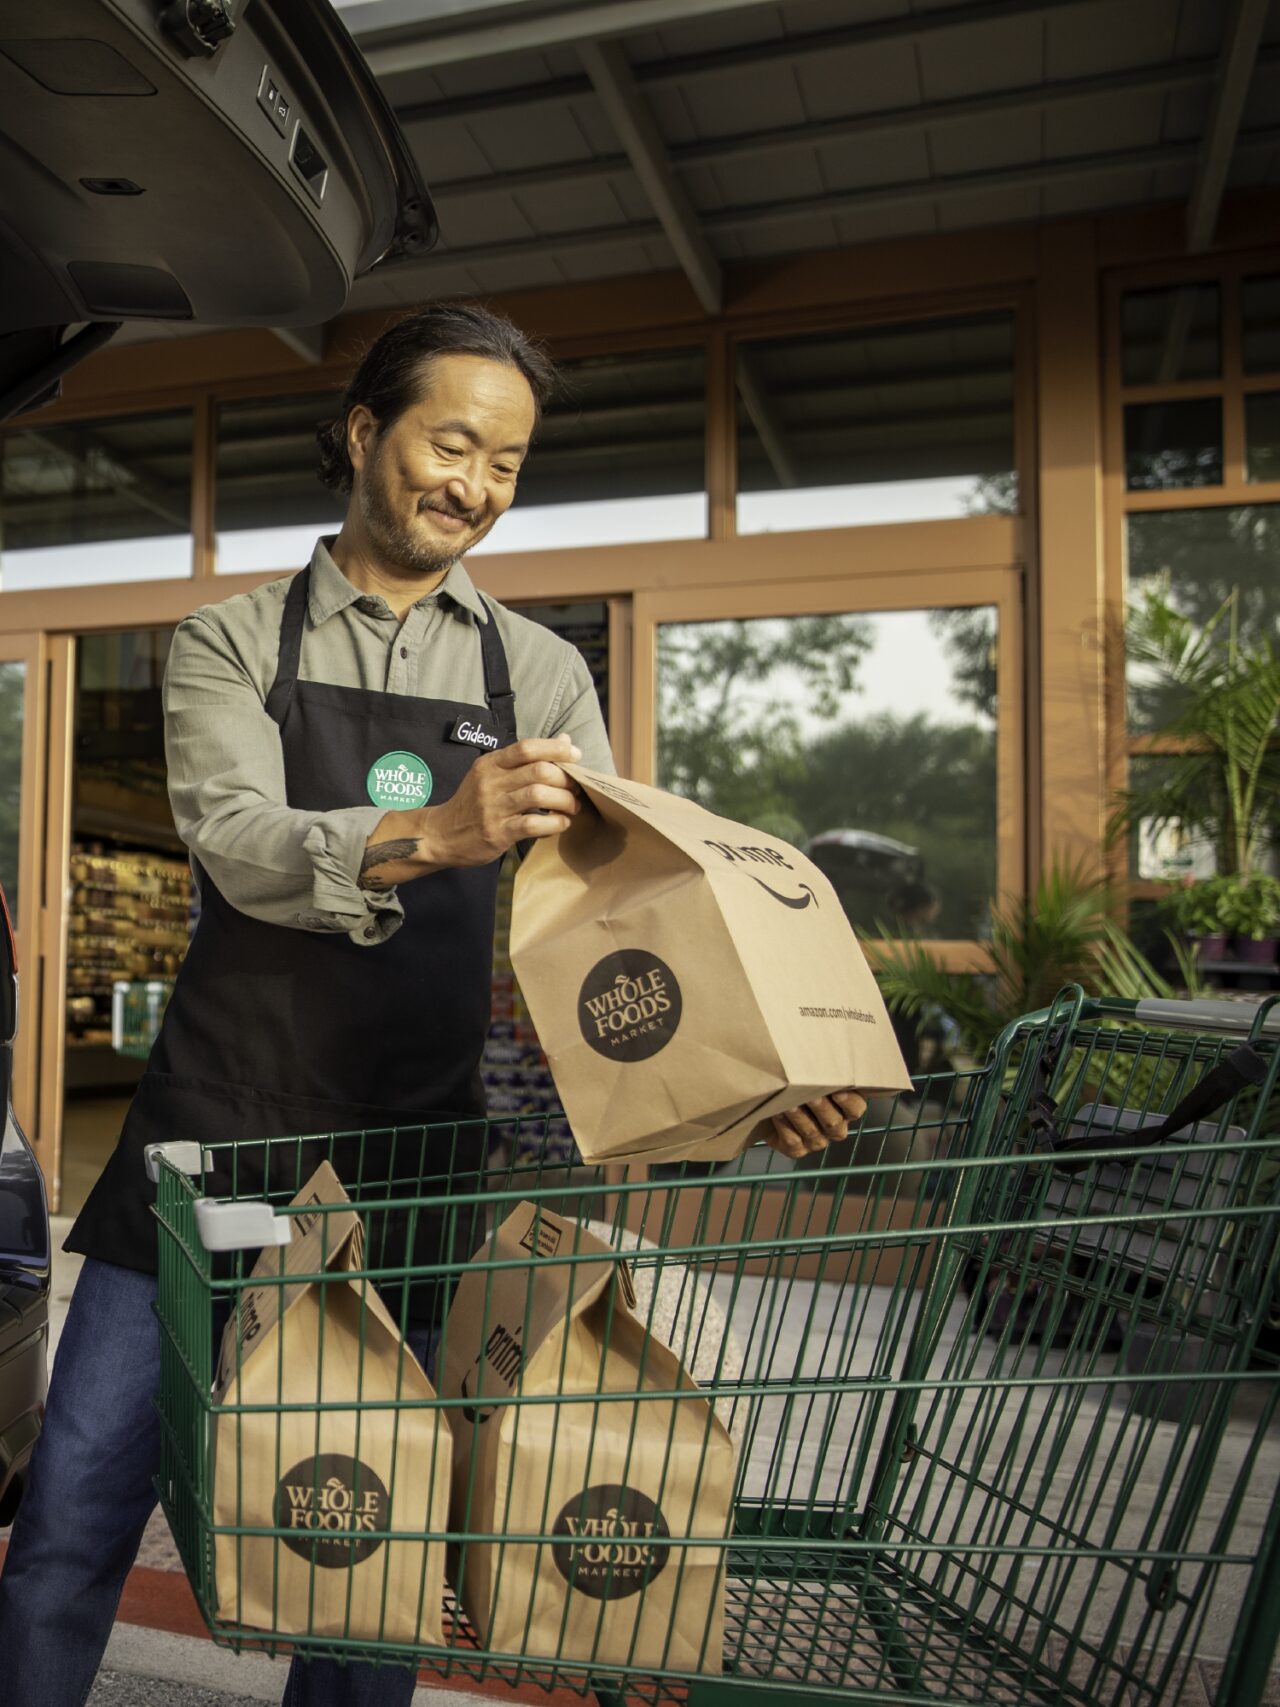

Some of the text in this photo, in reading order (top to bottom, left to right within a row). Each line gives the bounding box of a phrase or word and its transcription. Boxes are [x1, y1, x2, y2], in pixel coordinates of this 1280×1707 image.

[457, 721, 498, 749] Gideon
[374, 766, 426, 785] WHOLE
[375, 780, 423, 797] FOODS
[380, 795, 416, 804] MARKET
[701, 840, 794, 871] prime
[584, 968, 666, 1018] WHOLE
[594, 990, 672, 1038] FOODS
[798, 1005, 876, 1024] amazon.com/wholefoods
[610, 1017, 664, 1047] MARKET
[285, 1483, 380, 1513] WHOLE
[290, 1508, 377, 1532] FOODS
